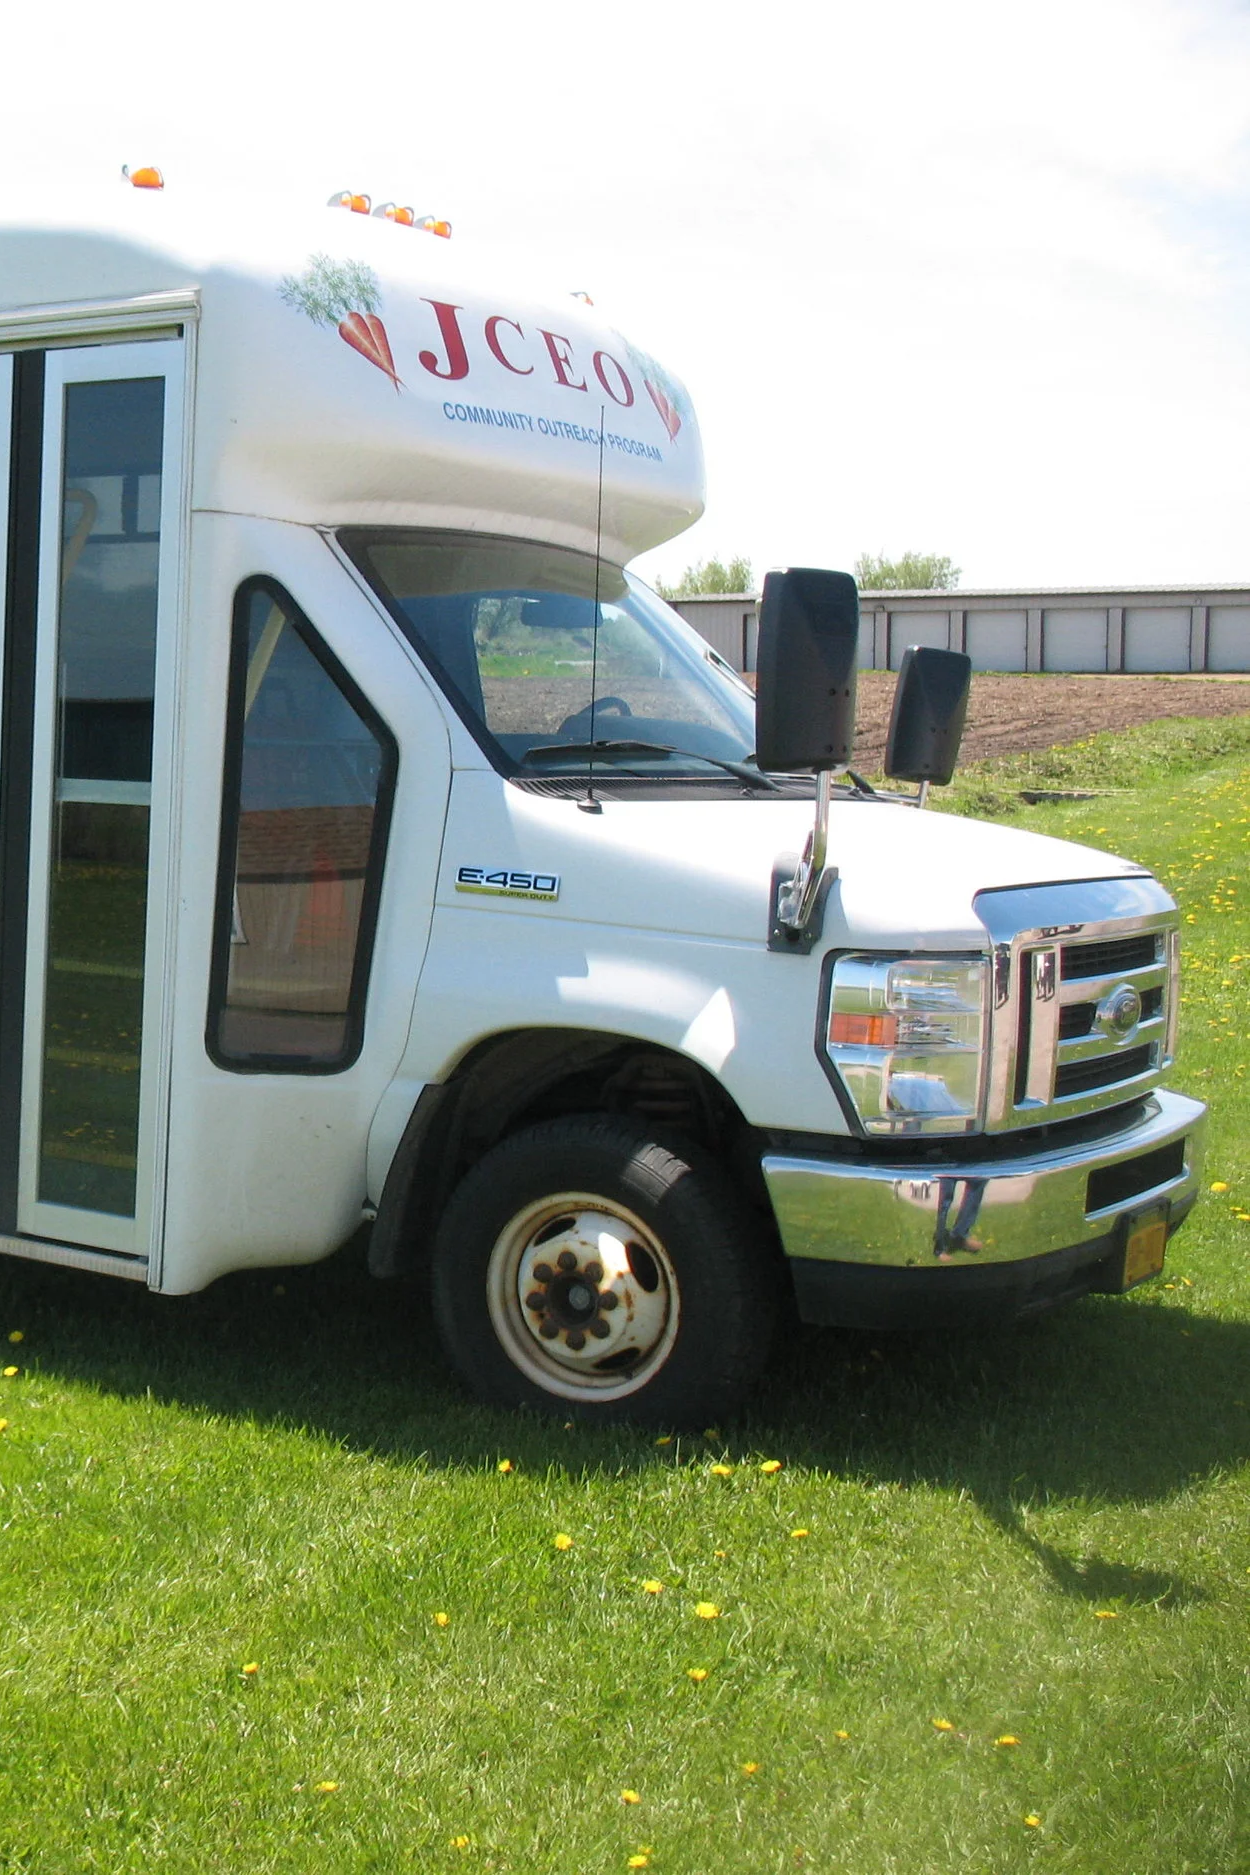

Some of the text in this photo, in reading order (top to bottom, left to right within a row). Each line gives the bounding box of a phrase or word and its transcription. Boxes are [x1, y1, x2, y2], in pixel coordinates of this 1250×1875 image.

[418, 297, 634, 408] JCEO
[443, 402, 663, 463] COMMUNITY OUTREACH PROGRAM
[457, 867, 557, 892] E-450
[499, 889, 555, 901] SUPER DUTY
